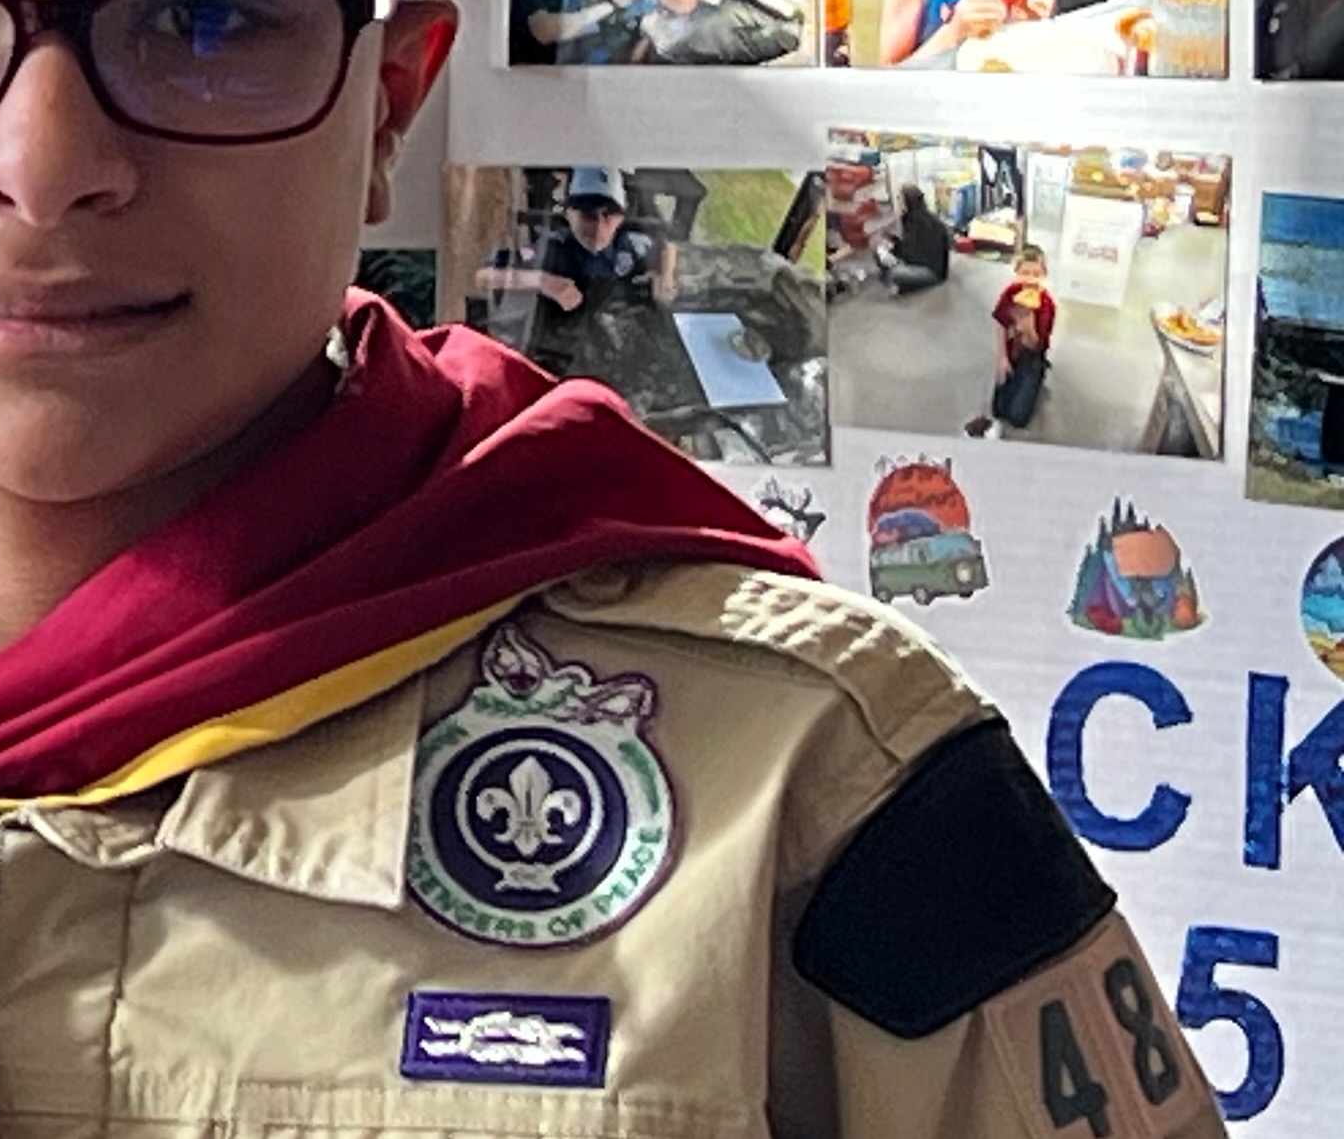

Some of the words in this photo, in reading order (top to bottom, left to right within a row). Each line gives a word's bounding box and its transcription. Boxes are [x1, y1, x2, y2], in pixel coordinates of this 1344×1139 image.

[592, 826, 662, 908] PEACE
[1039, 956, 1181, 1138] 48
[1176, 925, 1285, 1122] 5
